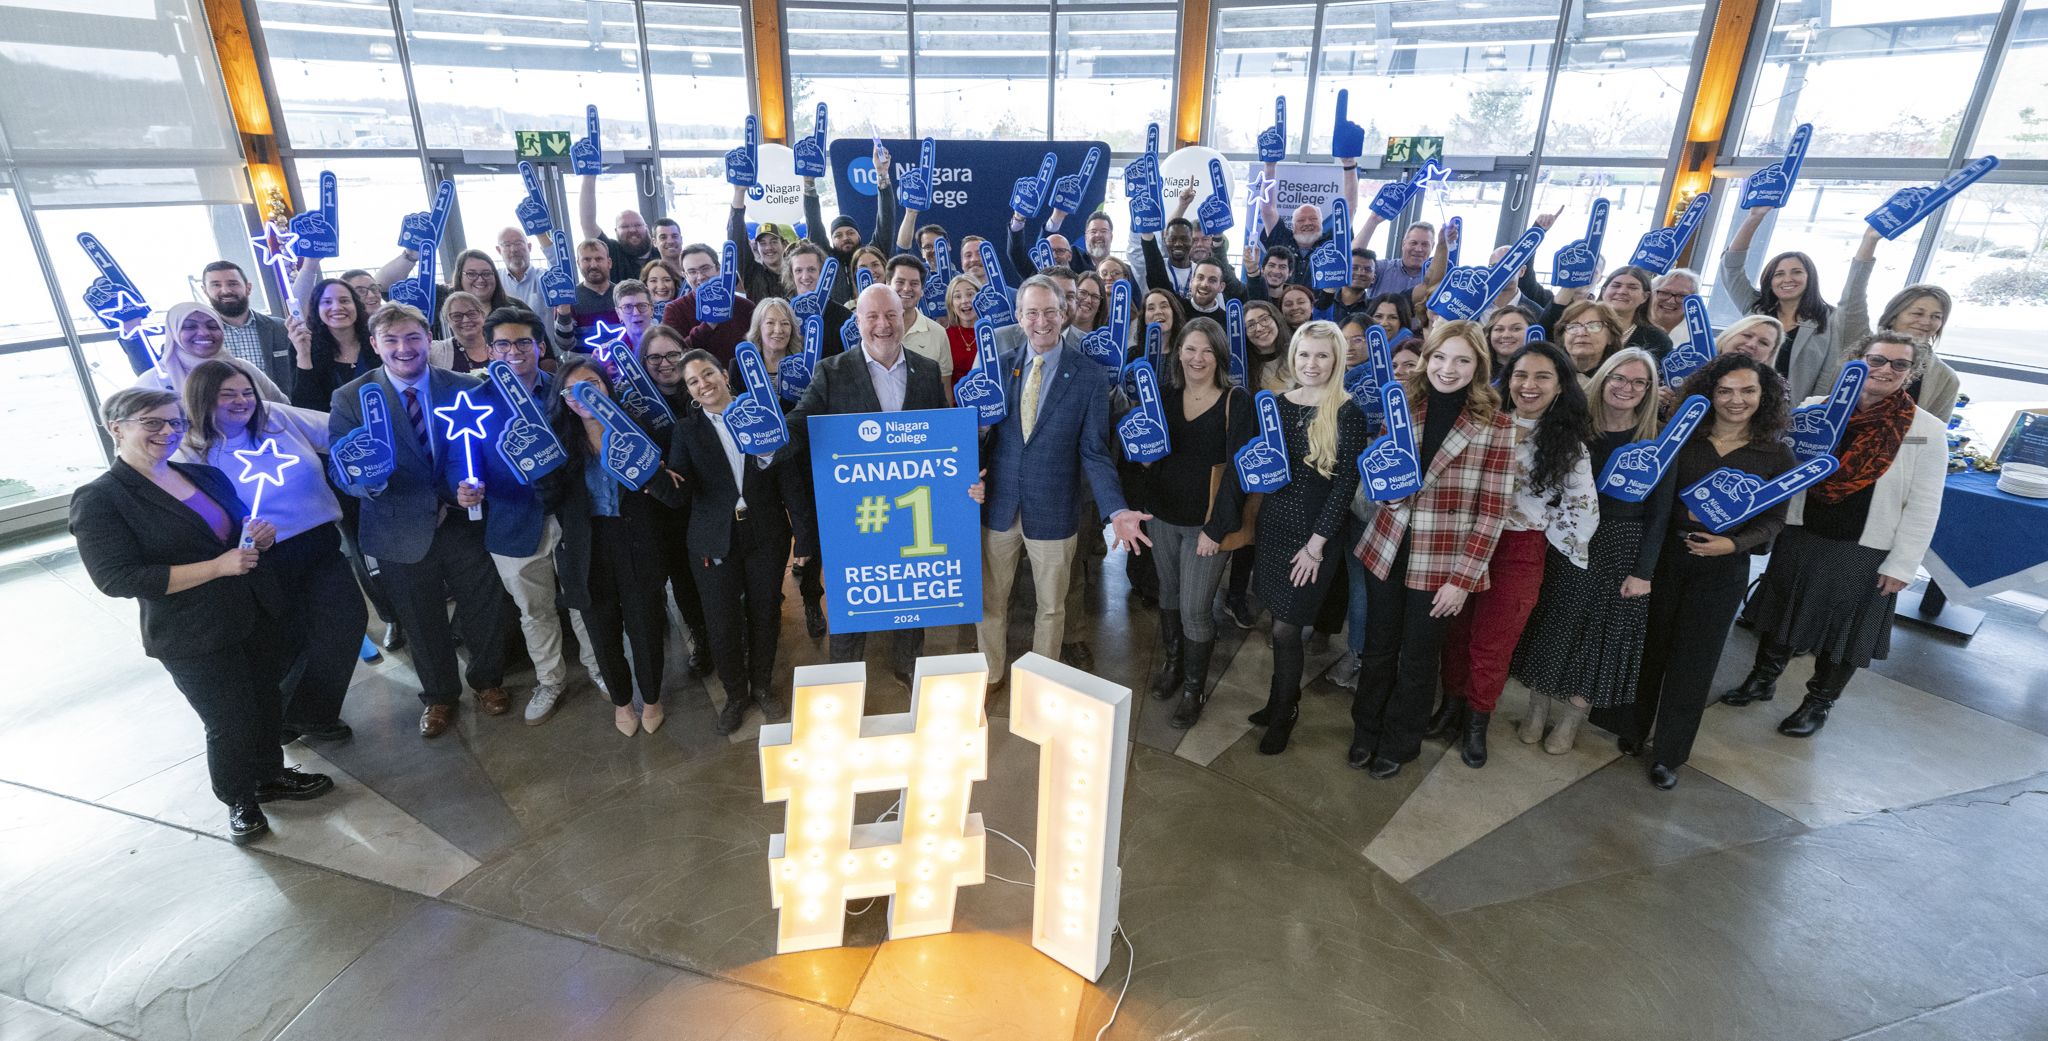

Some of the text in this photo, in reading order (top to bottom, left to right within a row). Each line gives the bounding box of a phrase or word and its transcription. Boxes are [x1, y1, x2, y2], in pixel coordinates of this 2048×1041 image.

[895, 162, 972, 186] Ngara
[765, 183, 801, 195] Niagara
[1164, 177, 1200, 188] Niagaa
[1278, 180, 1338, 193] Research
[749, 187, 761, 196] nc
[1277, 191, 1325, 205] College
[766, 194, 800, 205] College
[1644, 256, 1665, 268] College
[1648, 252, 1668, 264] Niagara
[1571, 270, 1592, 278] Niagara
[1451, 297, 1475, 316] Niagara
[991, 310, 1010, 319] Niagara
[993, 316, 1011, 324] College
[980, 401, 1003, 412] Niagara
[981, 408, 1004, 419] College
[862, 425, 878, 436] nc
[885, 420, 930, 433] Niagara
[753, 427, 781, 440] Niagara
[886, 432, 927, 445] College
[754, 435, 781, 447] College
[1140, 439, 1165, 450] Niagara
[1798, 440, 1829, 450] Niagara
[533, 442, 558, 461] Niagara
[1141, 445, 1164, 456] College
[363, 457, 391, 472] Niagara
[538, 450, 561, 466] College
[365, 464, 391, 478] College
[834, 458, 958, 484] CANADA'S
[1261, 468, 1286, 480] Niagara
[1262, 474, 1286, 486] College
[1389, 471, 1416, 485] Niagara
[1390, 478, 1416, 491] College
[1700, 502, 1723, 525] College
[1708, 497, 1731, 522] Niagara
[855, 485, 948, 558] #1
[845, 559, 961, 583] RESEARCH
[846, 579, 963, 605] COLLEGE
[894, 614, 920, 624] 2024
[759, 651, 1132, 983] #1
